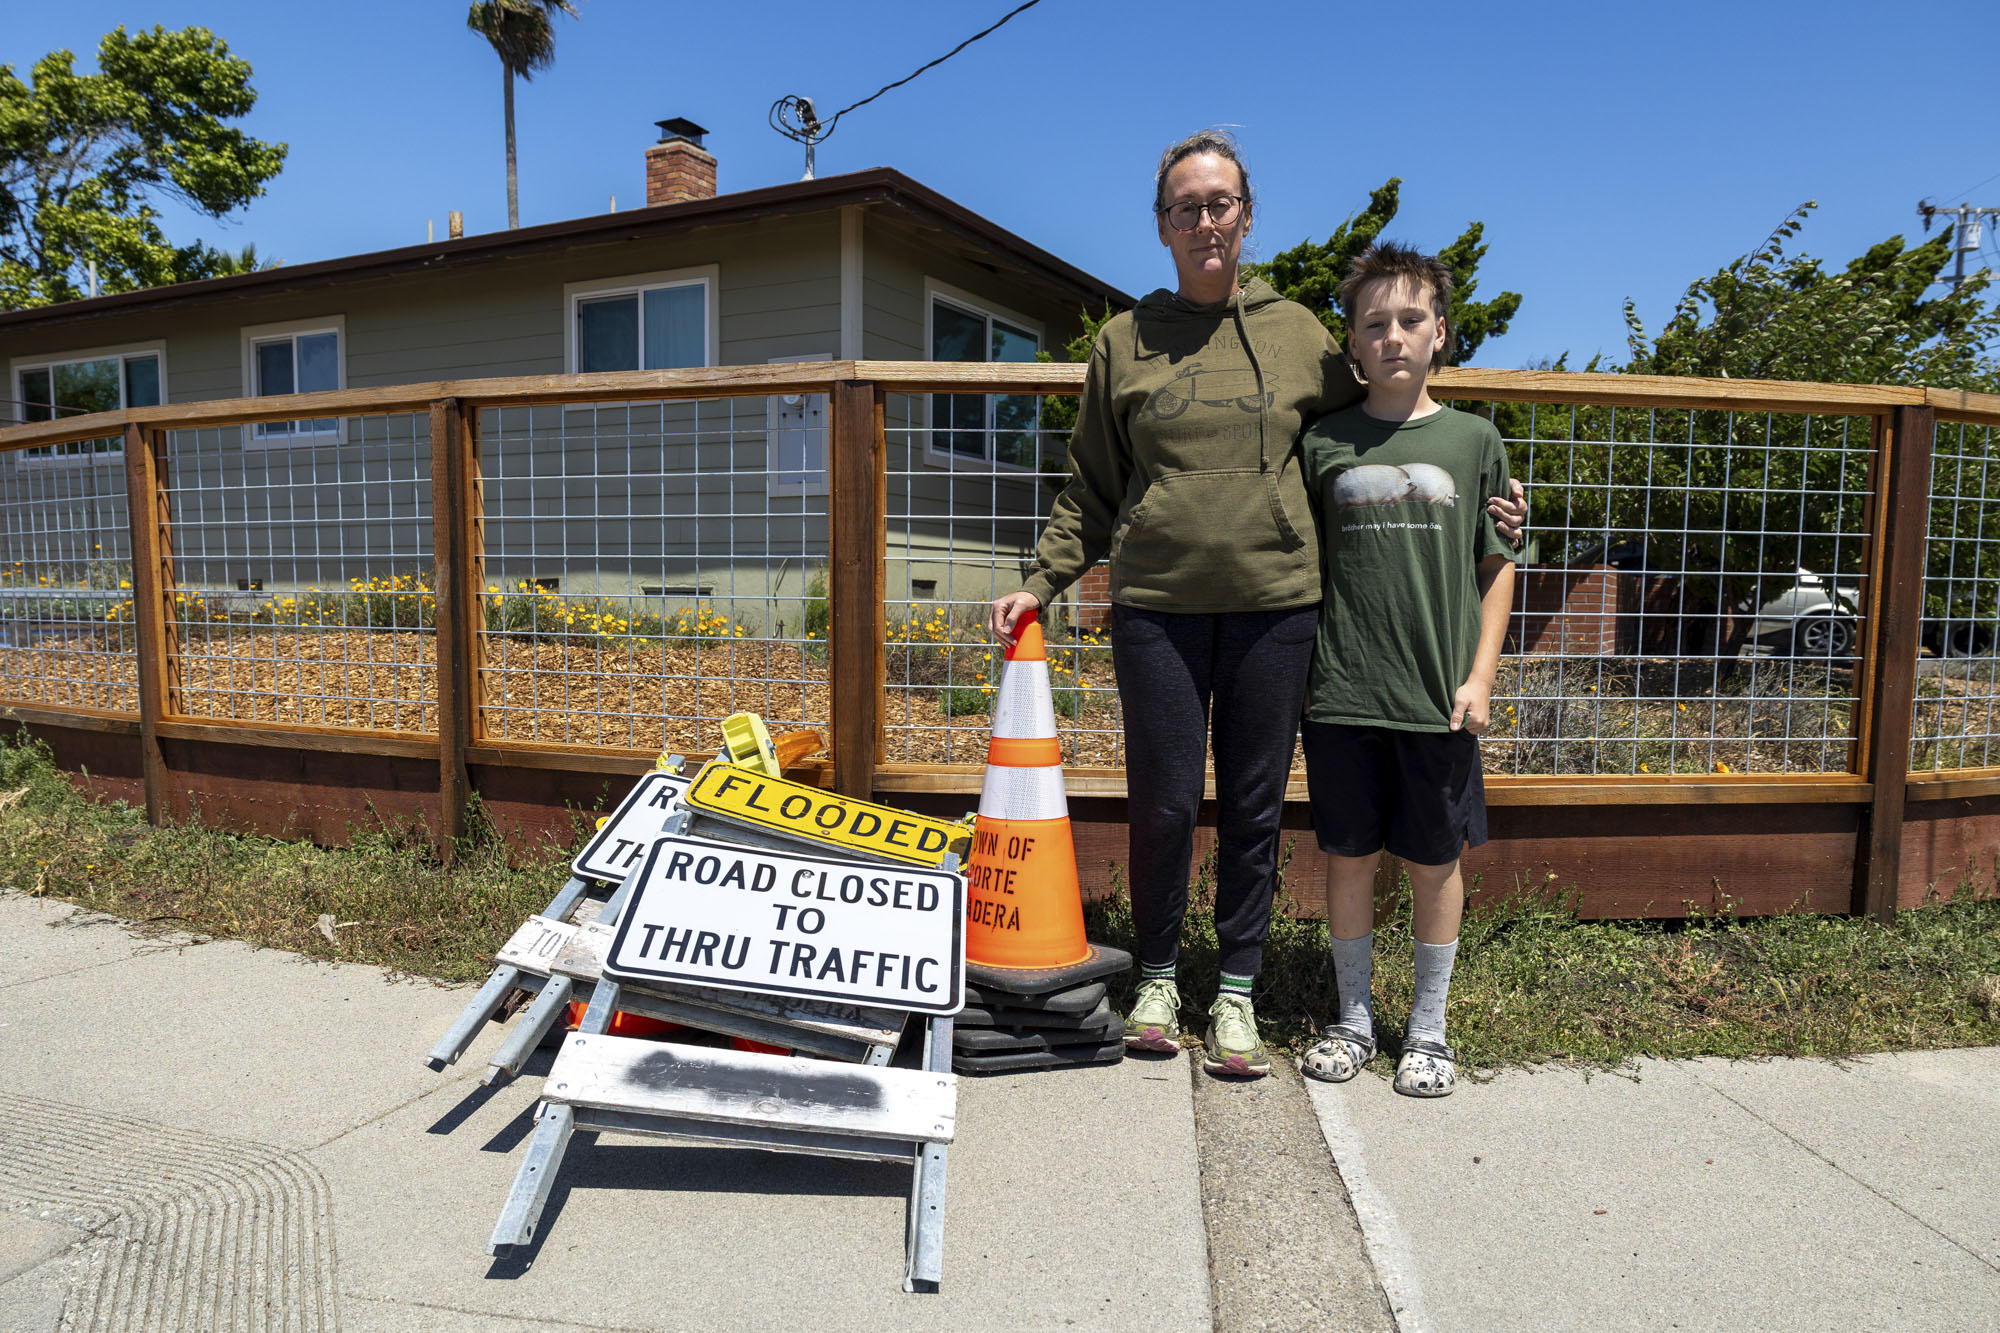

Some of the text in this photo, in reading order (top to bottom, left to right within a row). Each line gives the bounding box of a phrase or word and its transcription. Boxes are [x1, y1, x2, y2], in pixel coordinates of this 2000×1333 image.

[1365, 522, 1381, 531] may
[1387, 521, 1406, 529] have
[1406, 522, 1428, 530] some
[713, 774, 949, 853] FLOODED
[972, 829, 1036, 861] OWN OF
[664, 850, 940, 912] ROAD CLOSED
[772, 903, 826, 935] TO
[966, 896, 1020, 932] ADERA
[638, 923, 939, 993] THRU TRAFFIC
